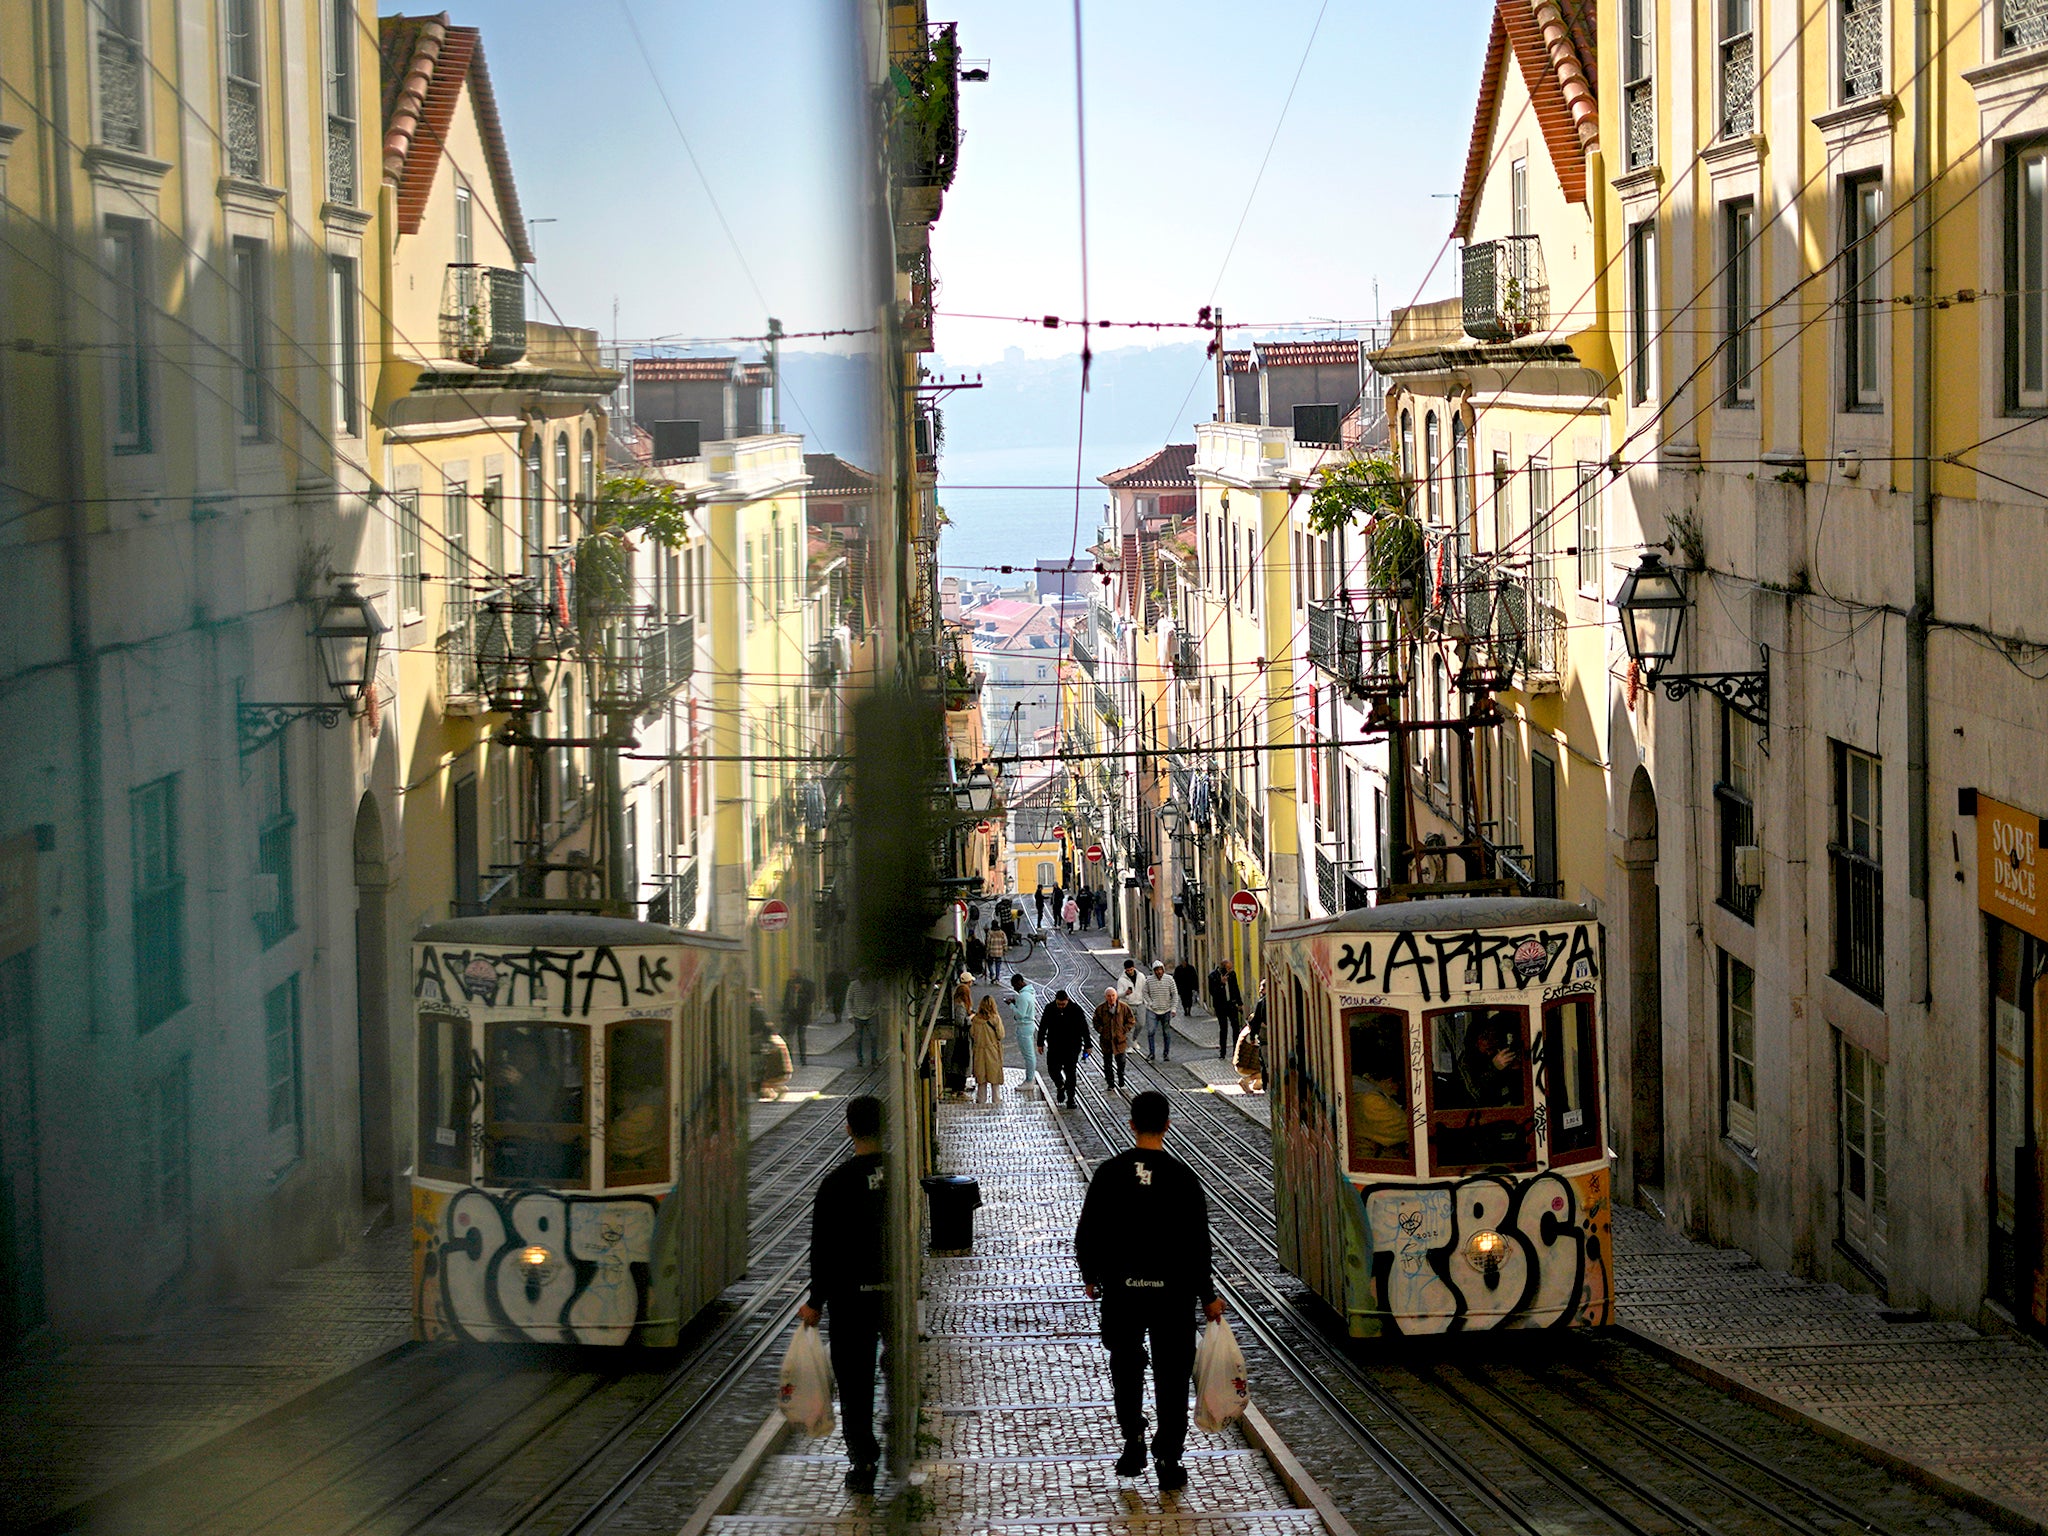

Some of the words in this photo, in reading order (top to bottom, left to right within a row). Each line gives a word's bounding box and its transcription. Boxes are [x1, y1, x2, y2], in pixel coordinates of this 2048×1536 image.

[1993, 819, 2036, 867] SOBE
[1994, 858, 2036, 900] DESCE
[1125, 1278, 1164, 1288] California
